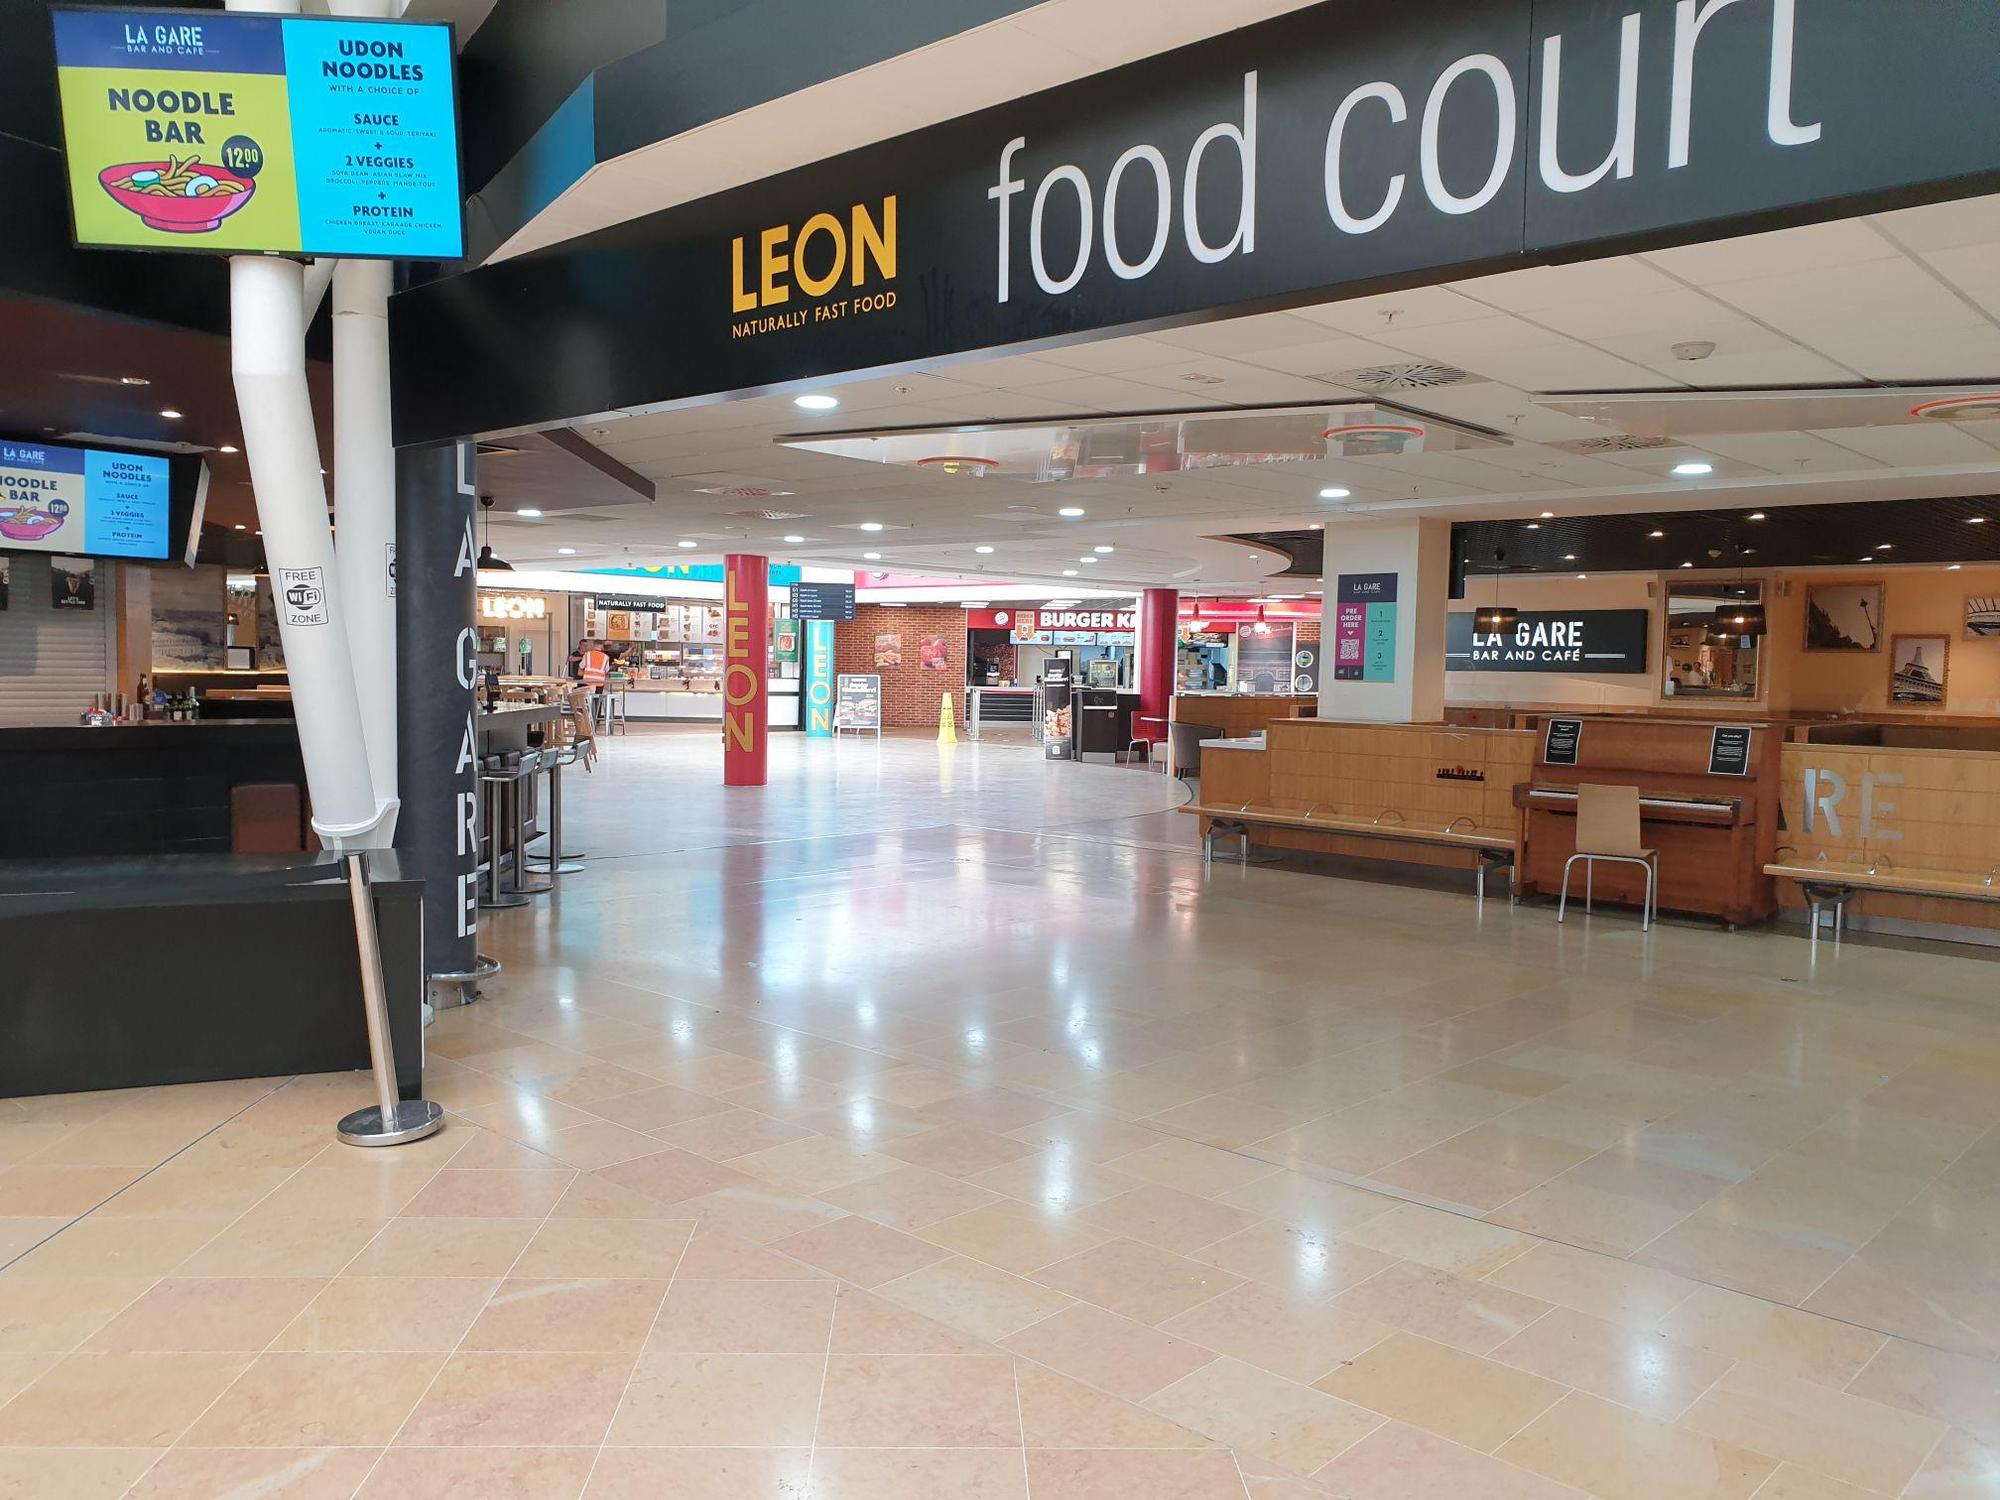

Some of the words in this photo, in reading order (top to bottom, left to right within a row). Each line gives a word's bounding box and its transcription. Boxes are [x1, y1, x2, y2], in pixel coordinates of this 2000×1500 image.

[125, 24, 148, 45] LA
[155, 25, 203, 47] GARE
[151, 46, 172, 54] AND
[339, 39, 403, 58] UDON
[322, 61, 424, 81] NOODLES
[328, 84, 353, 92] WITH
[367, 86, 403, 95] CHOICE
[406, 87, 419, 95] OF
[108, 88, 235, 116] NOODLE
[354, 113, 400, 126] SAUCE
[145, 119, 206, 145] BAR
[345, 155, 353, 166] 2
[356, 156, 414, 168] VEGGIES
[987, 69, 1257, 303] food
[353, 205, 414, 218] PROTEIN
[732, 195, 897, 313] LEON
[732, 309, 808, 339] NATURALLY
[814, 301, 848, 322] FAST
[853, 291, 897, 314] FOOD
[3, 447, 16, 457] LA
[19, 449, 45, 461] GARE
[111, 462, 143, 472] UDON
[102, 470, 152, 482] NOODLES
[0, 476, 58, 491] OODLE
[9, 489, 40, 502] BAR
[285, 570, 316, 581] FREE
[1353, 583, 1362, 591] LA
[1363, 582, 1381, 591] GARE
[632, 600, 647, 608] FAST
[648, 601, 665, 609] FOOD
[291, 613, 321, 624] ZONE
[1040, 612, 1114, 628] BURGER
[1515, 621, 1584, 647] GARE
[725, 570, 758, 752] LEON
[1472, 651, 1499, 661] BAR
[1504, 650, 1536, 661] AND
[1541, 648, 1580, 661] CAFÉ
[809, 627, 832, 731] LEON
